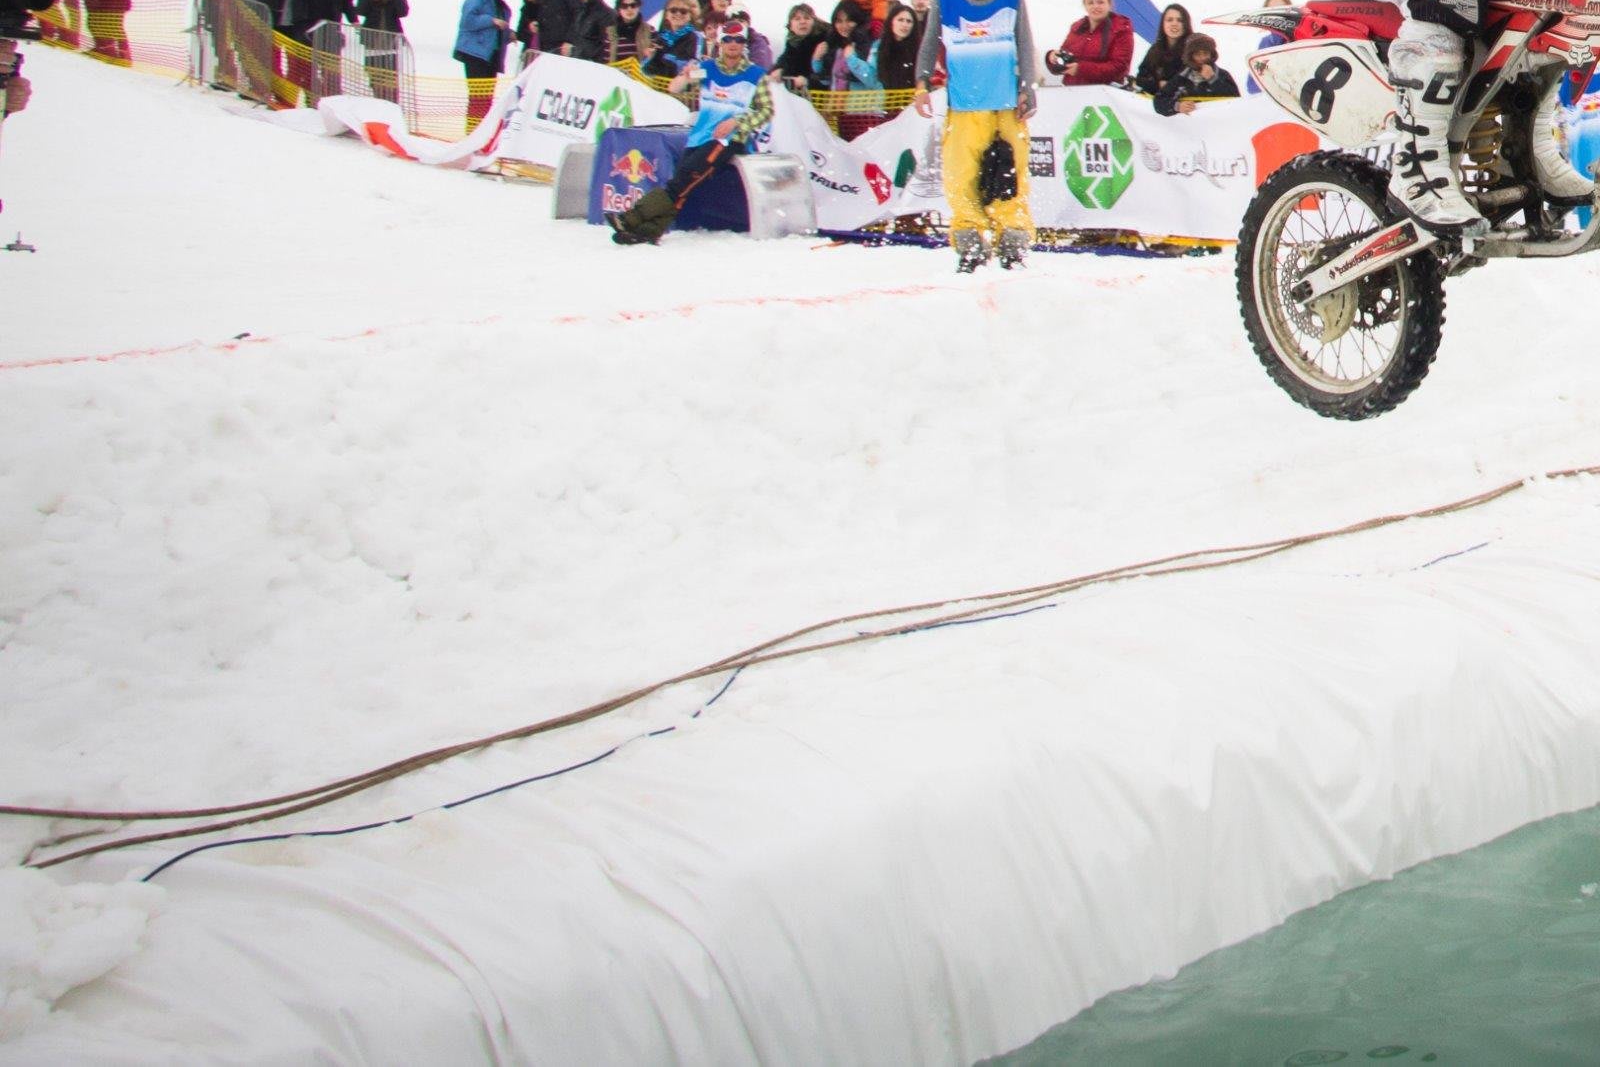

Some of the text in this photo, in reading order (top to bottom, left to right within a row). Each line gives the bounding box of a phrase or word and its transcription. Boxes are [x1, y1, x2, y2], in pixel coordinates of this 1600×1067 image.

[1334, 6, 1385, 17] HONDA
[1300, 56, 1353, 125] 8
[1085, 142, 1109, 162] IN
[1086, 163, 1109, 174] BOX
